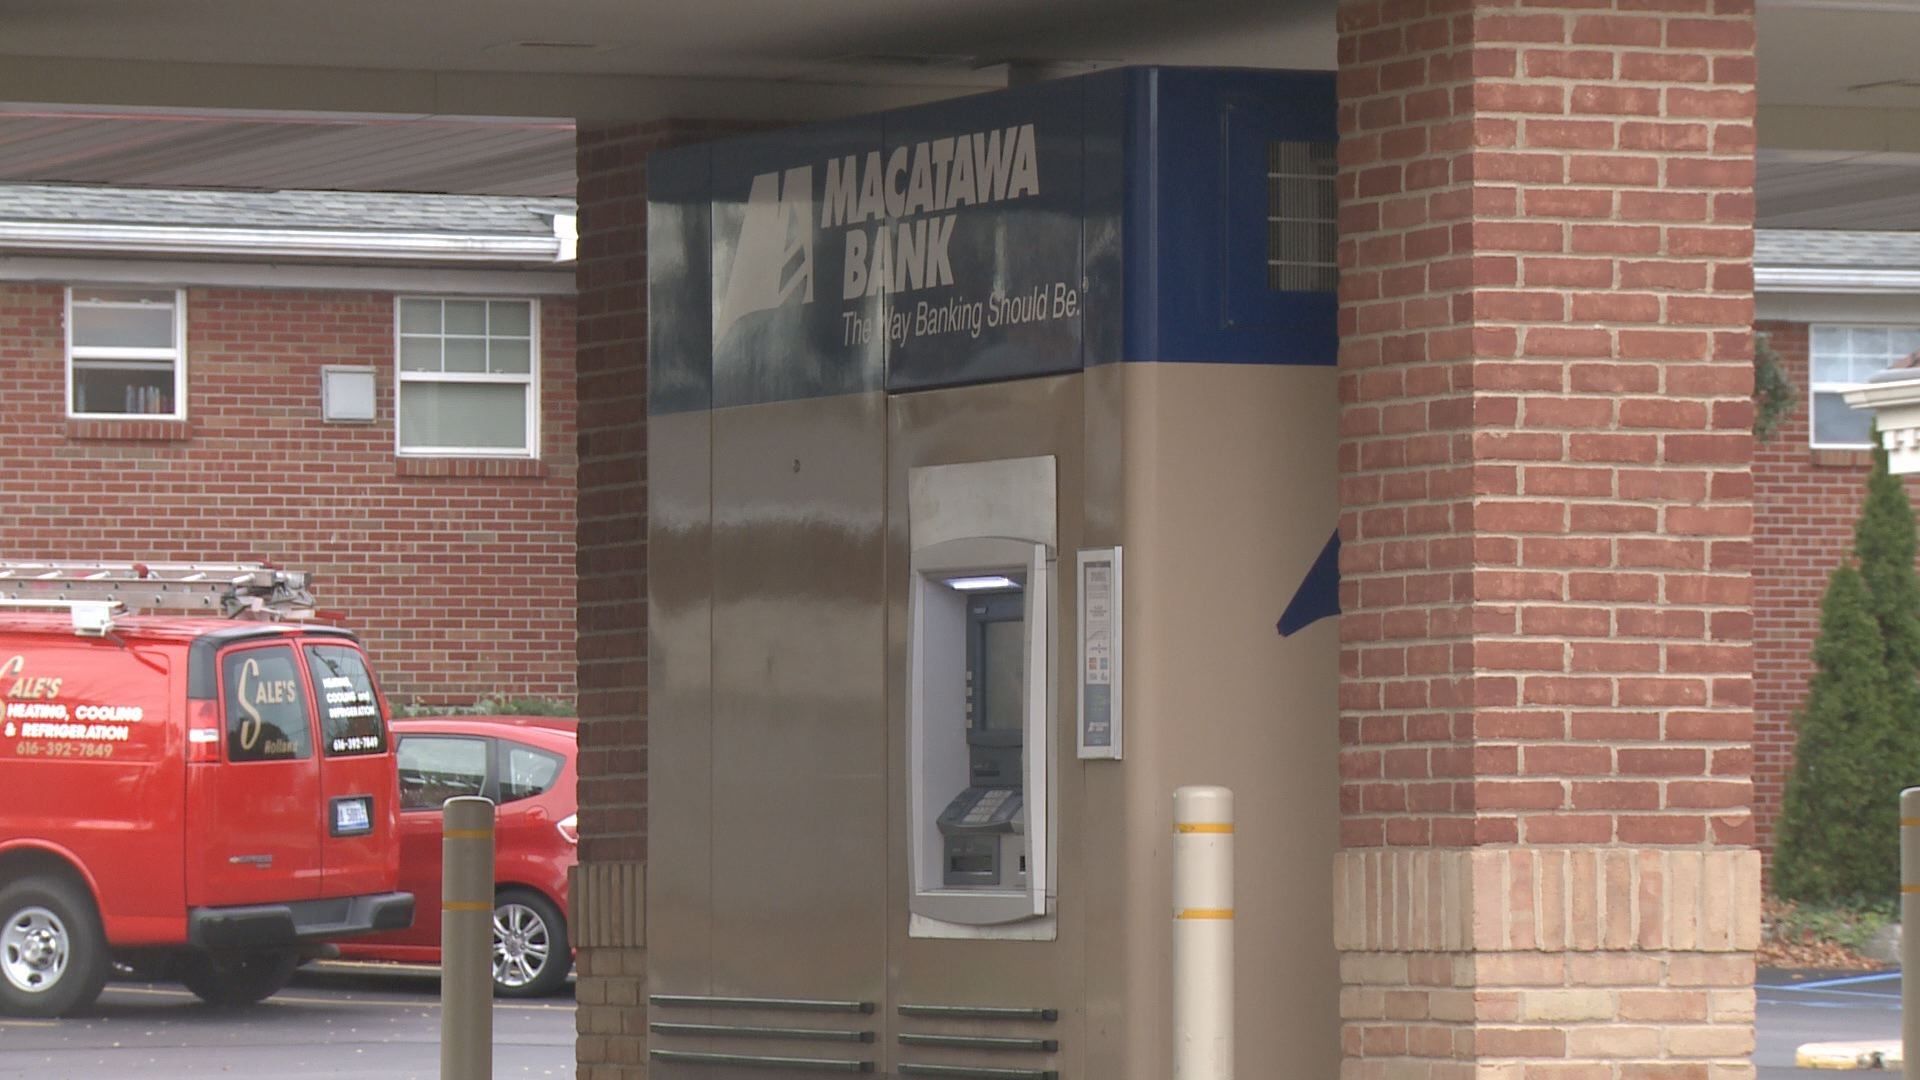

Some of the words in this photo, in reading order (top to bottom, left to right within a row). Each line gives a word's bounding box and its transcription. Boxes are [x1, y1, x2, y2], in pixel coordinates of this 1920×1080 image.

[821, 123, 1040, 229] MACATAWA
[843, 215, 957, 300] BANK
[842, 311, 873, 347] The
[915, 296, 982, 338] Banking
[988, 284, 1049, 327] Should
[1052, 282, 1080, 319] Be.
[4, 722, 17, 737] &
[21, 723, 129, 741] REFRIGERATION
[6, 703, 70, 721] HEATING,
[75, 705, 143, 722] COOLING
[238, 658, 296, 750] SALE'S
[16, 741, 113, 758] 616-392-7849
